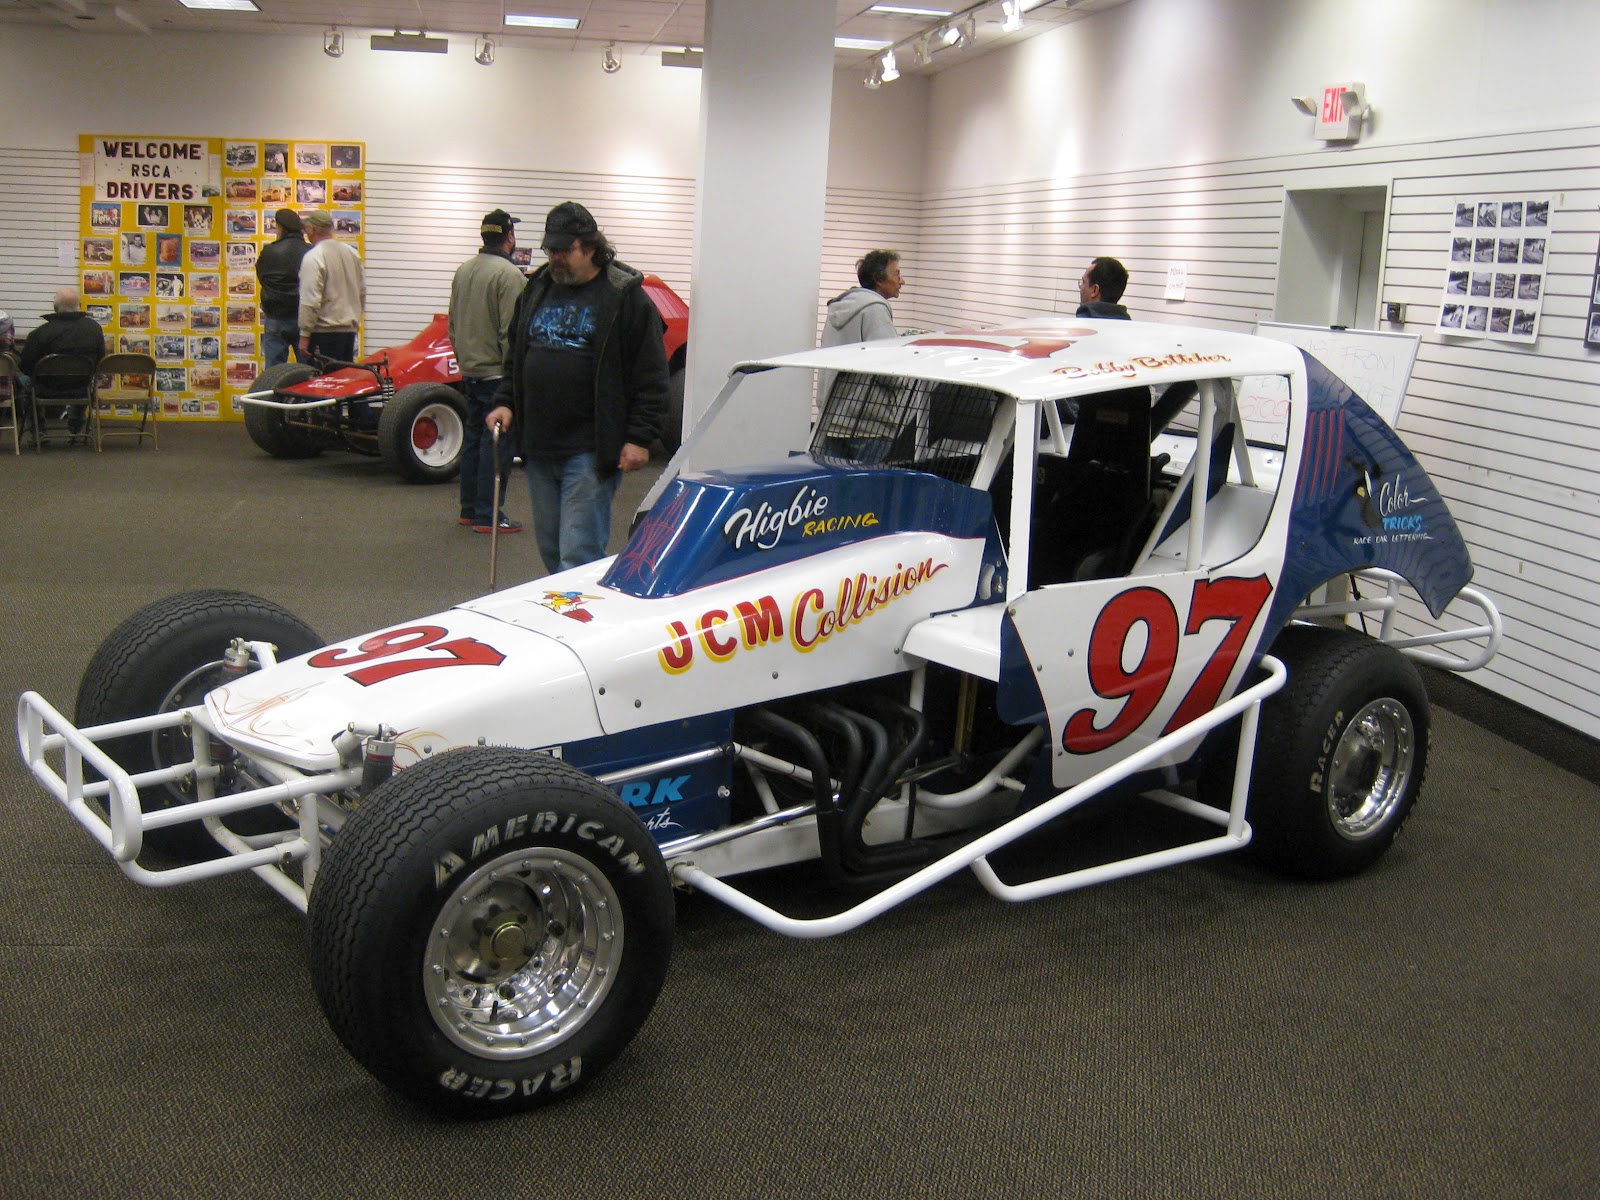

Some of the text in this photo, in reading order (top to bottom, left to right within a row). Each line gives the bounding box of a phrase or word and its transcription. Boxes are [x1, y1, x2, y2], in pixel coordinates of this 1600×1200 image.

[1322, 87, 1347, 123] EXIT
[103, 141, 201, 160] WELCOME
[131, 163, 171, 178] RSCA
[106, 181, 194, 200] DRIVERS
[1379, 474, 1428, 516] Color
[724, 485, 829, 550] Higbie
[802, 512, 879, 538] RACING
[1382, 514, 1424, 533] TRICKS
[1352, 536, 1372, 545] RACE
[658, 557, 949, 674] JCM Collision
[307, 625, 507, 688] 97
[1062, 572, 1274, 756] 97
[1309, 709, 1345, 794] RACER
[620, 774, 692, 807] RK
[433, 811, 646, 889] AMERICAN
[440, 1055, 582, 1101] RACER
